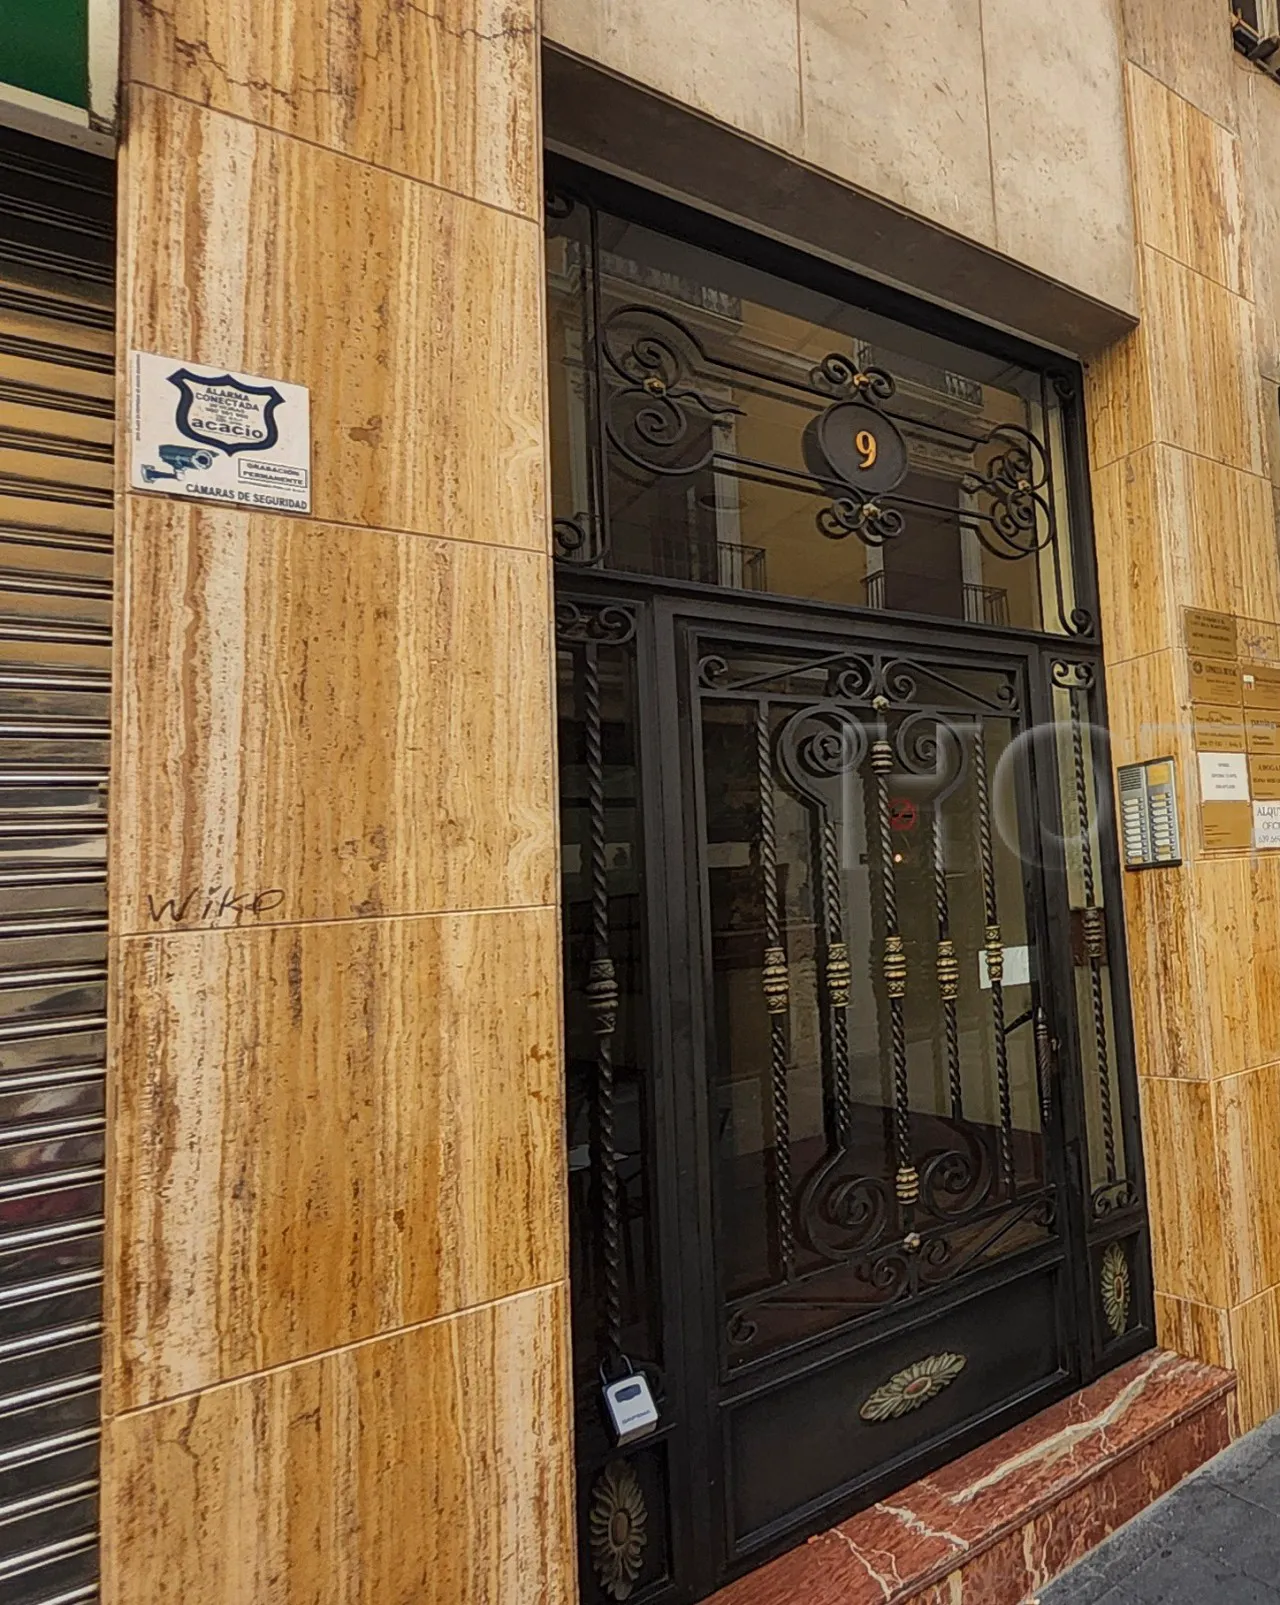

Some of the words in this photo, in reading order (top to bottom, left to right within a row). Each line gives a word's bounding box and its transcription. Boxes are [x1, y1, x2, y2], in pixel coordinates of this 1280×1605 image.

[195, 392, 260, 412] CONECTADA
[205, 387, 251, 402] ALARMA
[191, 418, 264, 440] acacio
[855, 430, 877, 469] 9
[237, 491, 251, 502] DE
[252, 493, 308, 511] SEGURIDAD
